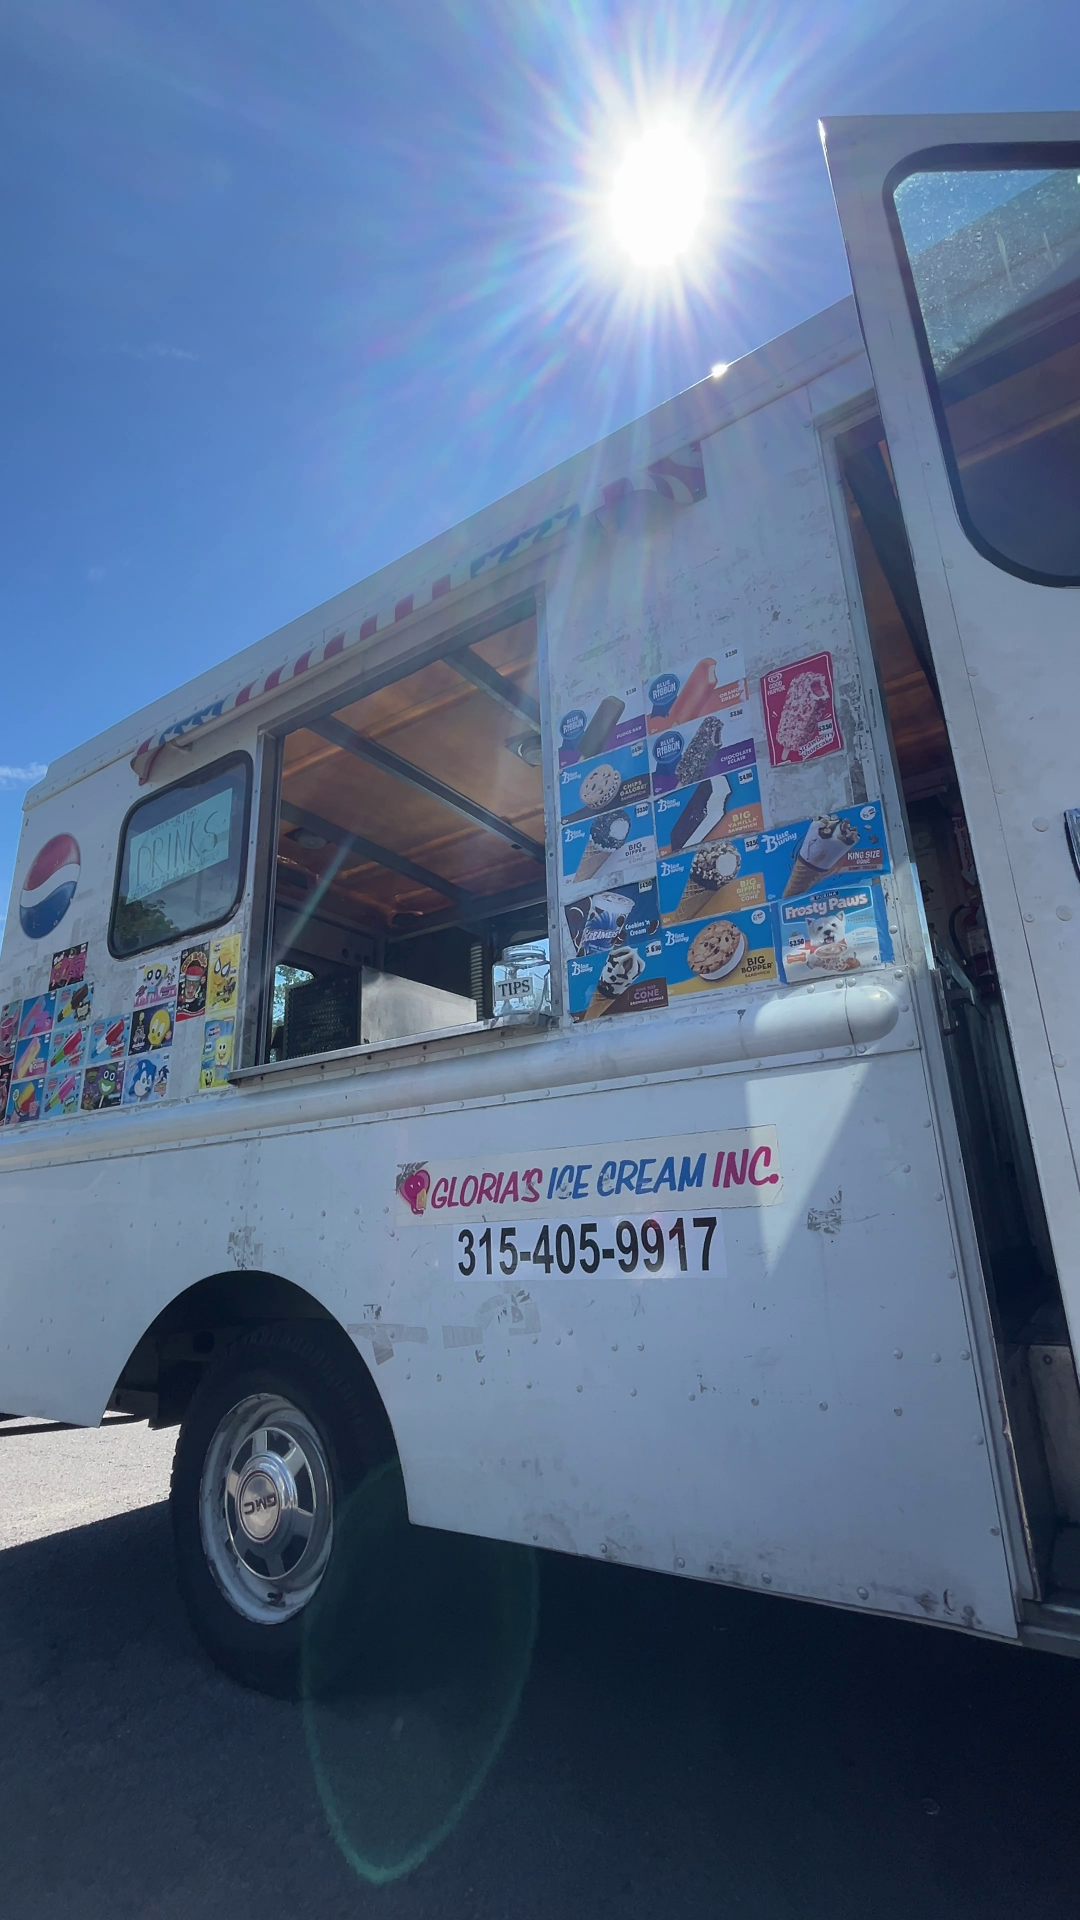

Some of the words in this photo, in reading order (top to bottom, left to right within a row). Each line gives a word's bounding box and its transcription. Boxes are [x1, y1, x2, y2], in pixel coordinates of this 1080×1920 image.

[656, 680, 670, 688] BLUE
[652, 682, 676, 700] RIBBON
[566, 715, 578, 724] BLUE
[562, 718, 584, 734] RIBBON
[616, 730, 632, 739] FUDGE
[660, 738, 674, 746] BLUE
[656, 740, 680, 757] RIBBON
[720, 748, 752, 762] CHOCOLATE
[728, 755, 746, 764] ECLAIR
[622, 780, 642, 790] CHIPS
[732, 810, 751, 822] BIG
[728, 817, 757, 828] VANILLA
[728, 822, 758, 834] SANDWICH
[137, 810, 218, 886] DRINKS
[625, 846, 646, 856] DIPPER
[628, 842, 642, 850] BIG
[848, 852, 864, 860] KING
[866, 850, 880, 858] SIZE
[740, 878, 756, 888] BIG
[736, 884, 762, 894] DIPPER
[785, 900, 828, 920] Frosty
[828, 894, 868, 910] Paws
[625, 921, 645, 930] Cookies
[630, 928, 646, 936] Cream
[747, 956, 766, 966] BIG
[741, 962, 772, 974] BOPPER
[498, 980, 530, 996] TIPS
[634, 988, 660, 1000] CONE
[430, 1168, 544, 1209] GLORIA'S
[547, 1164, 592, 1200] ICE
[596, 1152, 707, 1197] CREAM
[712, 1145, 780, 1188] INC.
[458, 1216, 718, 1276] 315-405-9917
[244, 1493, 276, 1515] GMC
